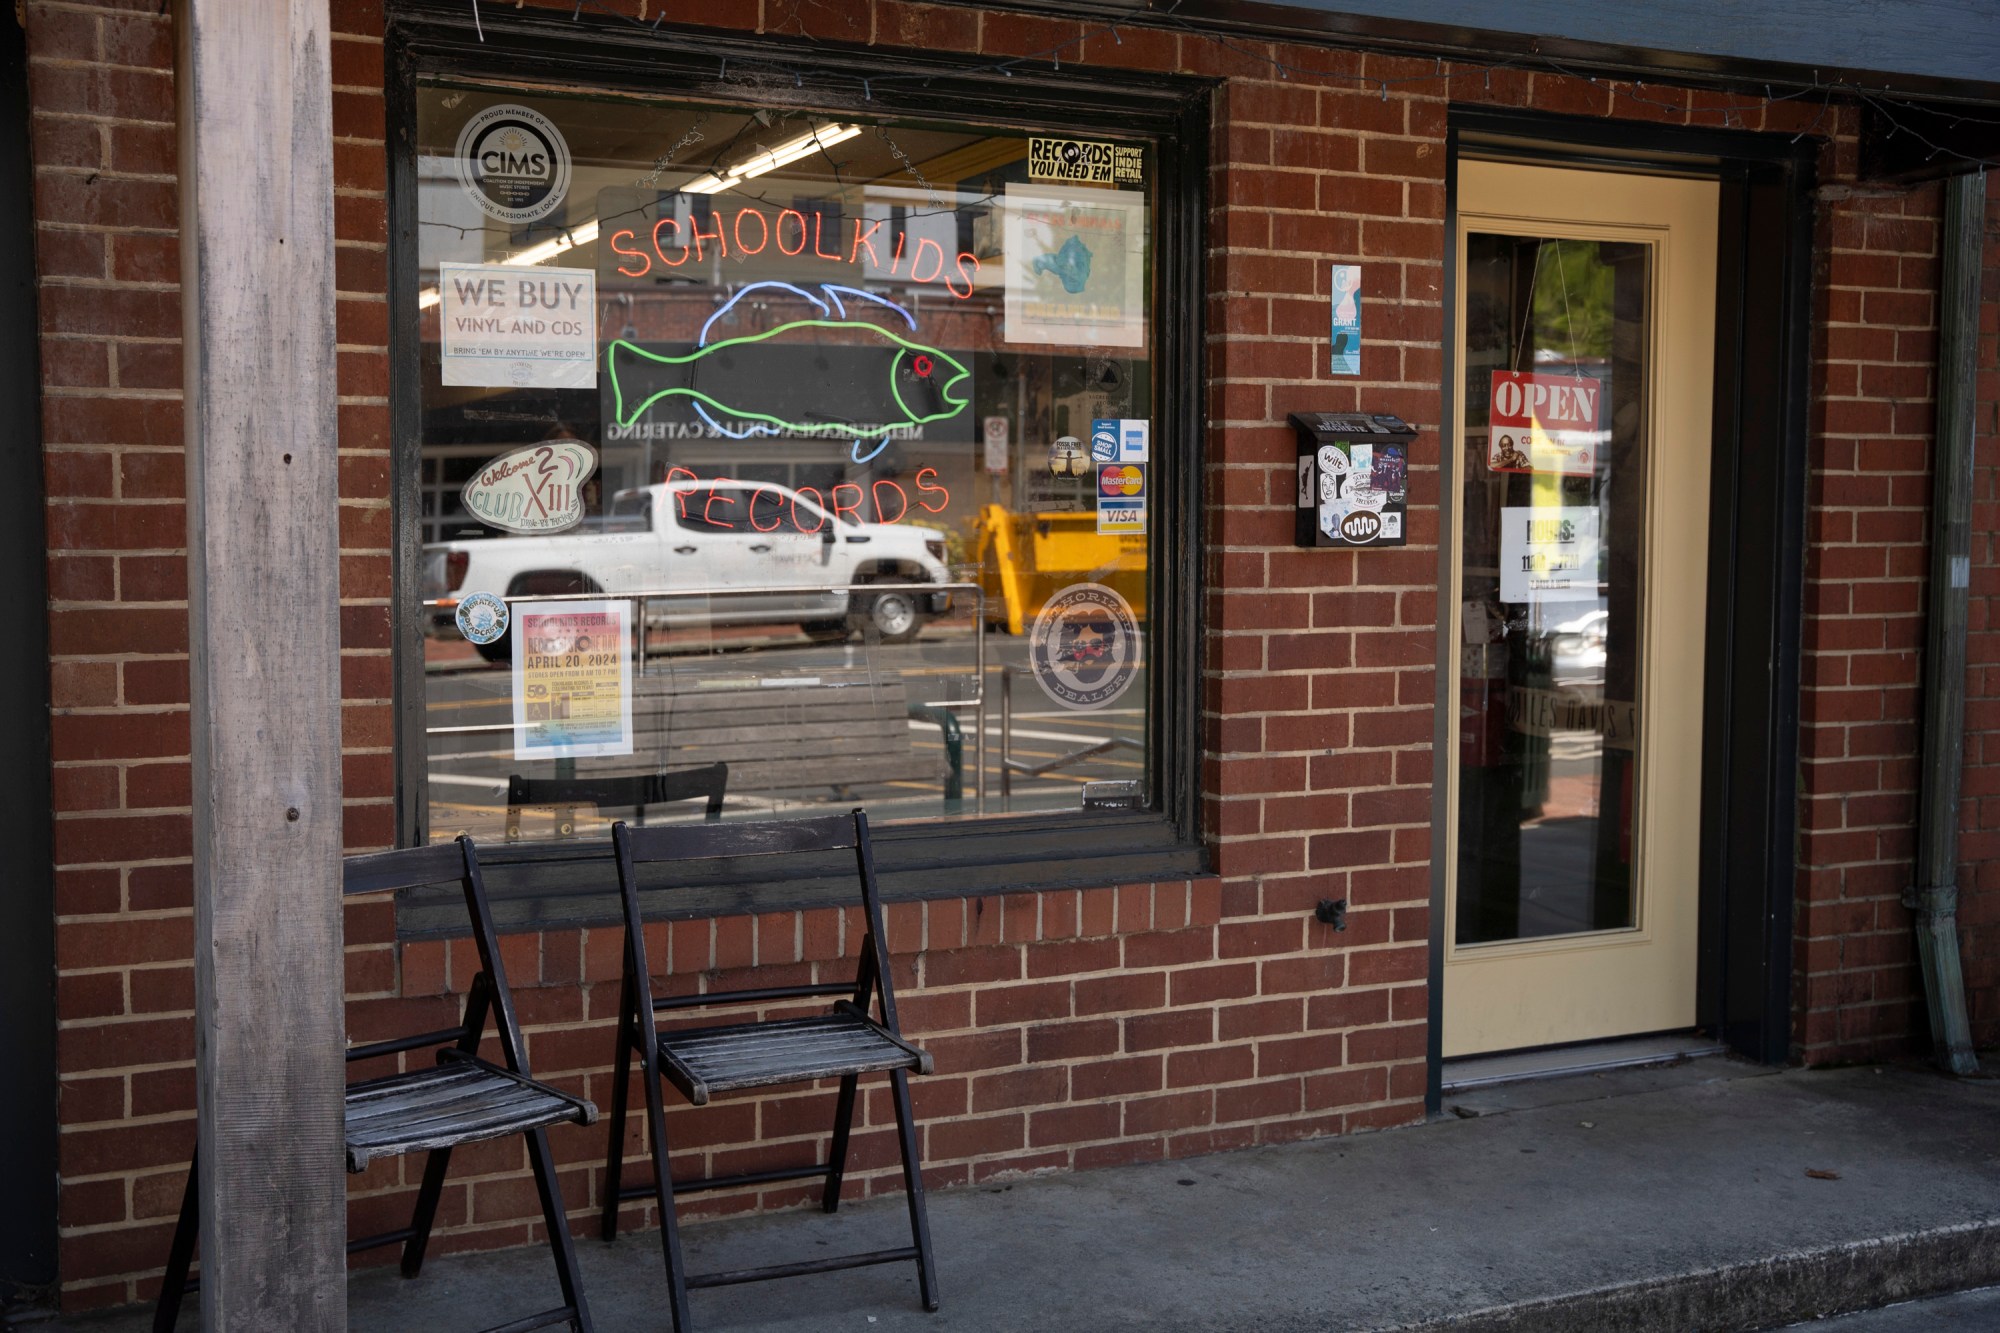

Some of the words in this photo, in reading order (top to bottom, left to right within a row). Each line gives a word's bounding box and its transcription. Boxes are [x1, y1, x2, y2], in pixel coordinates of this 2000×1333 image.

[481, 109, 504, 122] PROUD
[505, 109, 535, 119] MEMBER
[535, 117, 545, 126] OF
[1031, 139, 1112, 165] RECORDS
[1115, 146, 1142, 157] SUPPORT
[481, 151, 546, 176] CIMS
[1031, 160, 1055, 176] YOU
[1056, 162, 1090, 179] NEED
[1091, 165, 1112, 181] 'EM
[1115, 157, 1142, 169] INDIE
[1115, 167, 1142, 179] RETAIL
[470, 190, 495, 214] UNIQUE,
[496, 209, 541, 219] PASSIONATE,
[541, 194, 559, 212] LOCAL
[610, 207, 981, 299] SCHOOLKIDS
[453, 278, 507, 307] WE
[518, 280, 583, 310] BUY
[455, 317, 506, 333] VINYL
[511, 320, 546, 335] AND
[551, 321, 583, 336] CDS
[1333, 317, 1357, 327] GRANT
[453, 347, 477, 355] BRING
[506, 349, 538, 357] ANYTIME
[1495, 381, 1597, 422] OPEN
[481, 456, 537, 487] Welcome
[535, 446, 559, 475] 2
[1323, 452, 1344, 470] wilt
[1101, 476, 1142, 485] MasterCard
[472, 490, 524, 523] CLUB
[521, 472, 570, 518] XIII
[655, 466, 950, 534] RECORDS
[1106, 510, 1137, 522] VISA
[528, 656, 562, 668] APRIL
[565, 655, 584, 668] 20,
[588, 653, 617, 665] 2024
[549, 670, 564, 678] OPEN
[1053, 674, 1127, 702] DEALER
[1508, 690, 1557, 728] MILES
[1566, 698, 1617, 739] DAVIS
